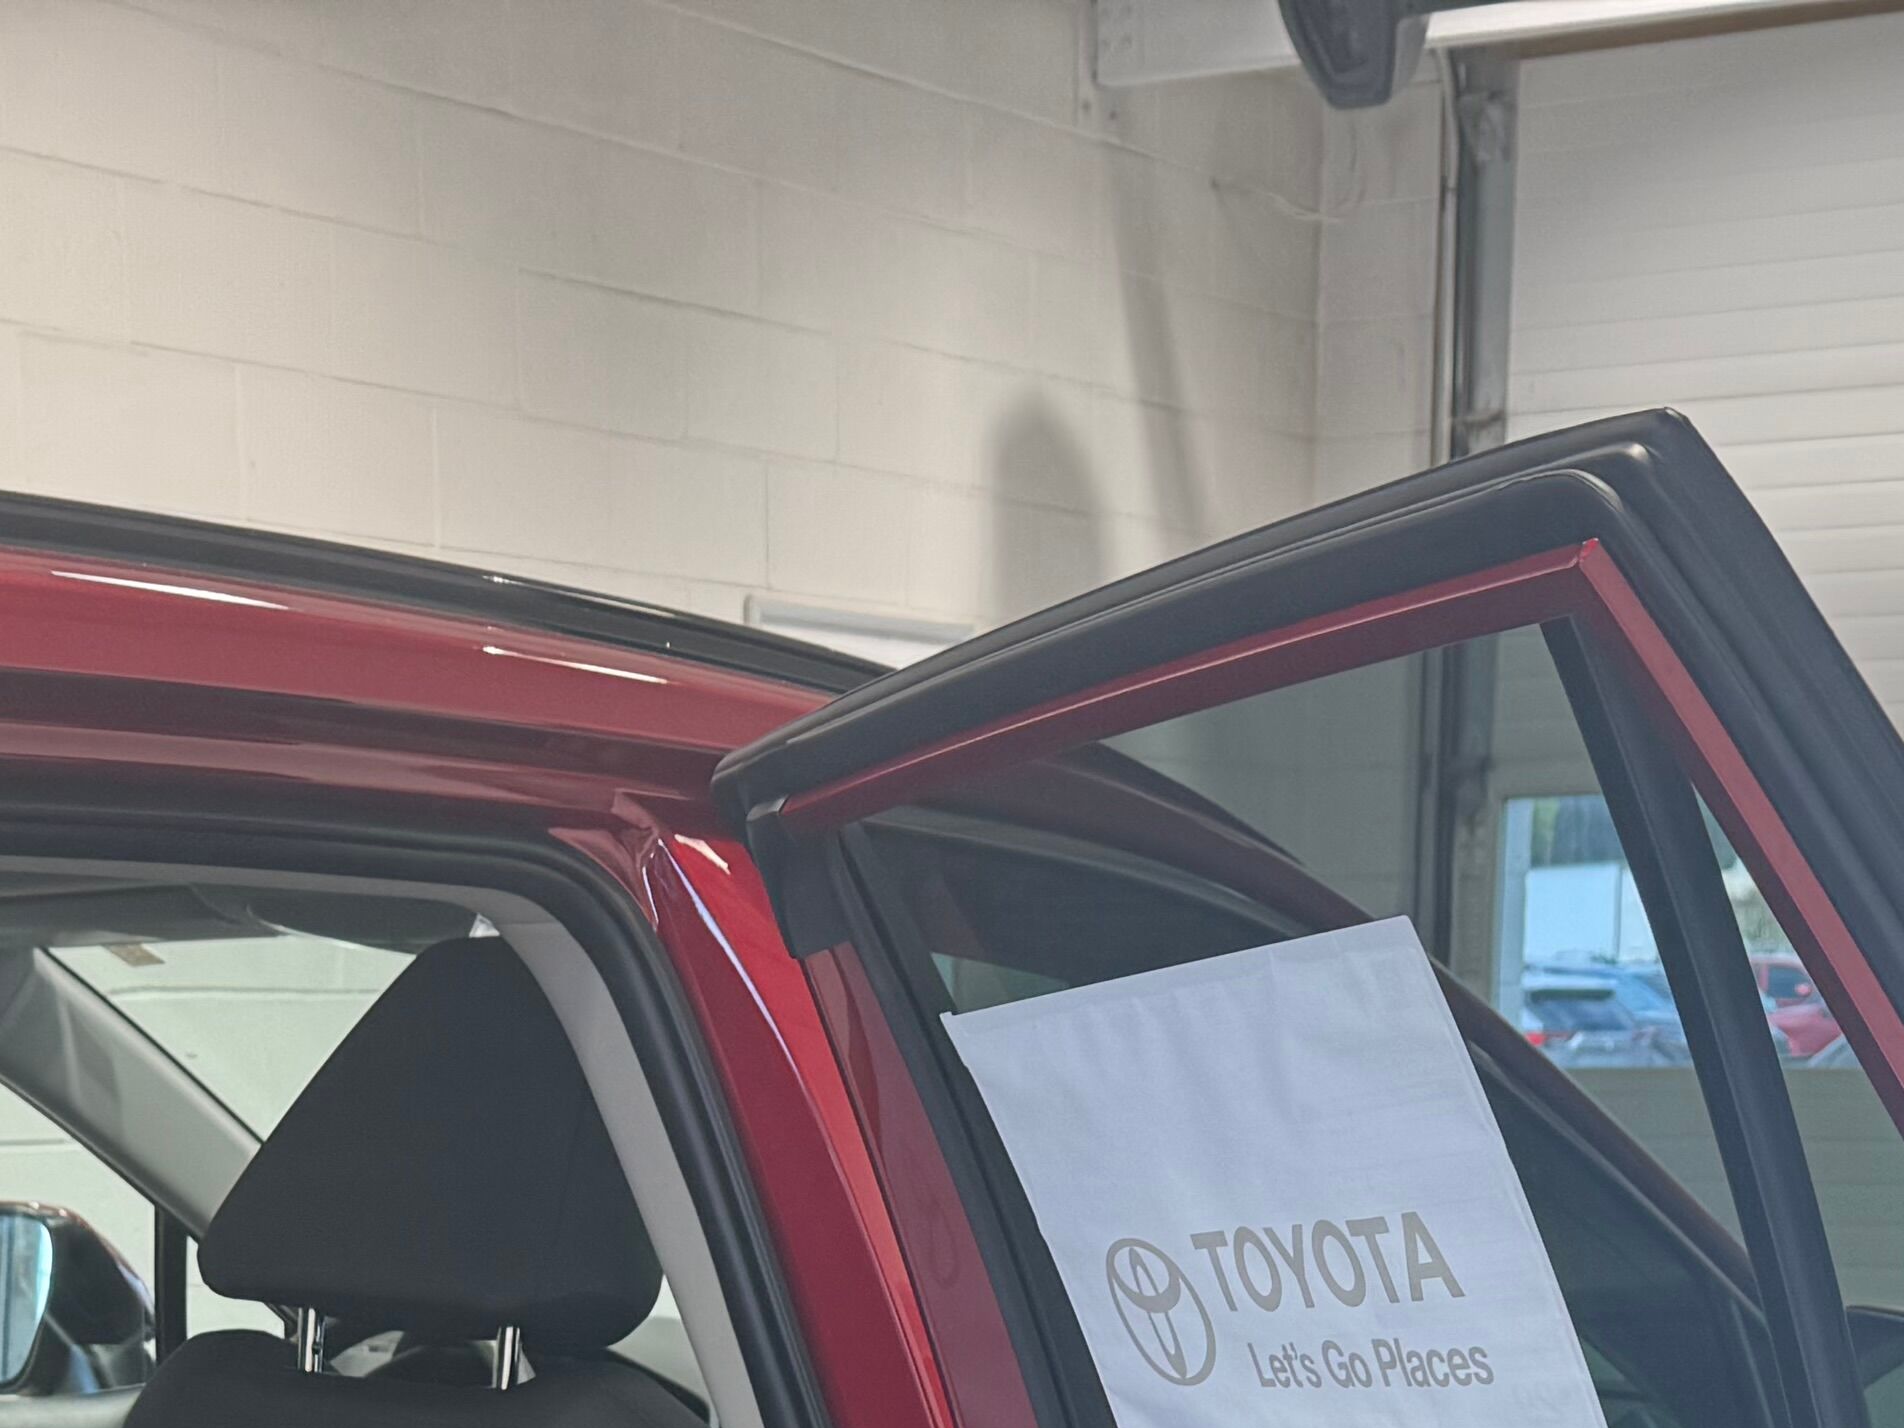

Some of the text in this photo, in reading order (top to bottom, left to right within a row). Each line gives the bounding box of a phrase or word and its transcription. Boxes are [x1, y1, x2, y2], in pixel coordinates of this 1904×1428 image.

[1190, 1211, 1466, 1312] TOYOTA
[1247, 1337, 1495, 1389] Let's Go Places
